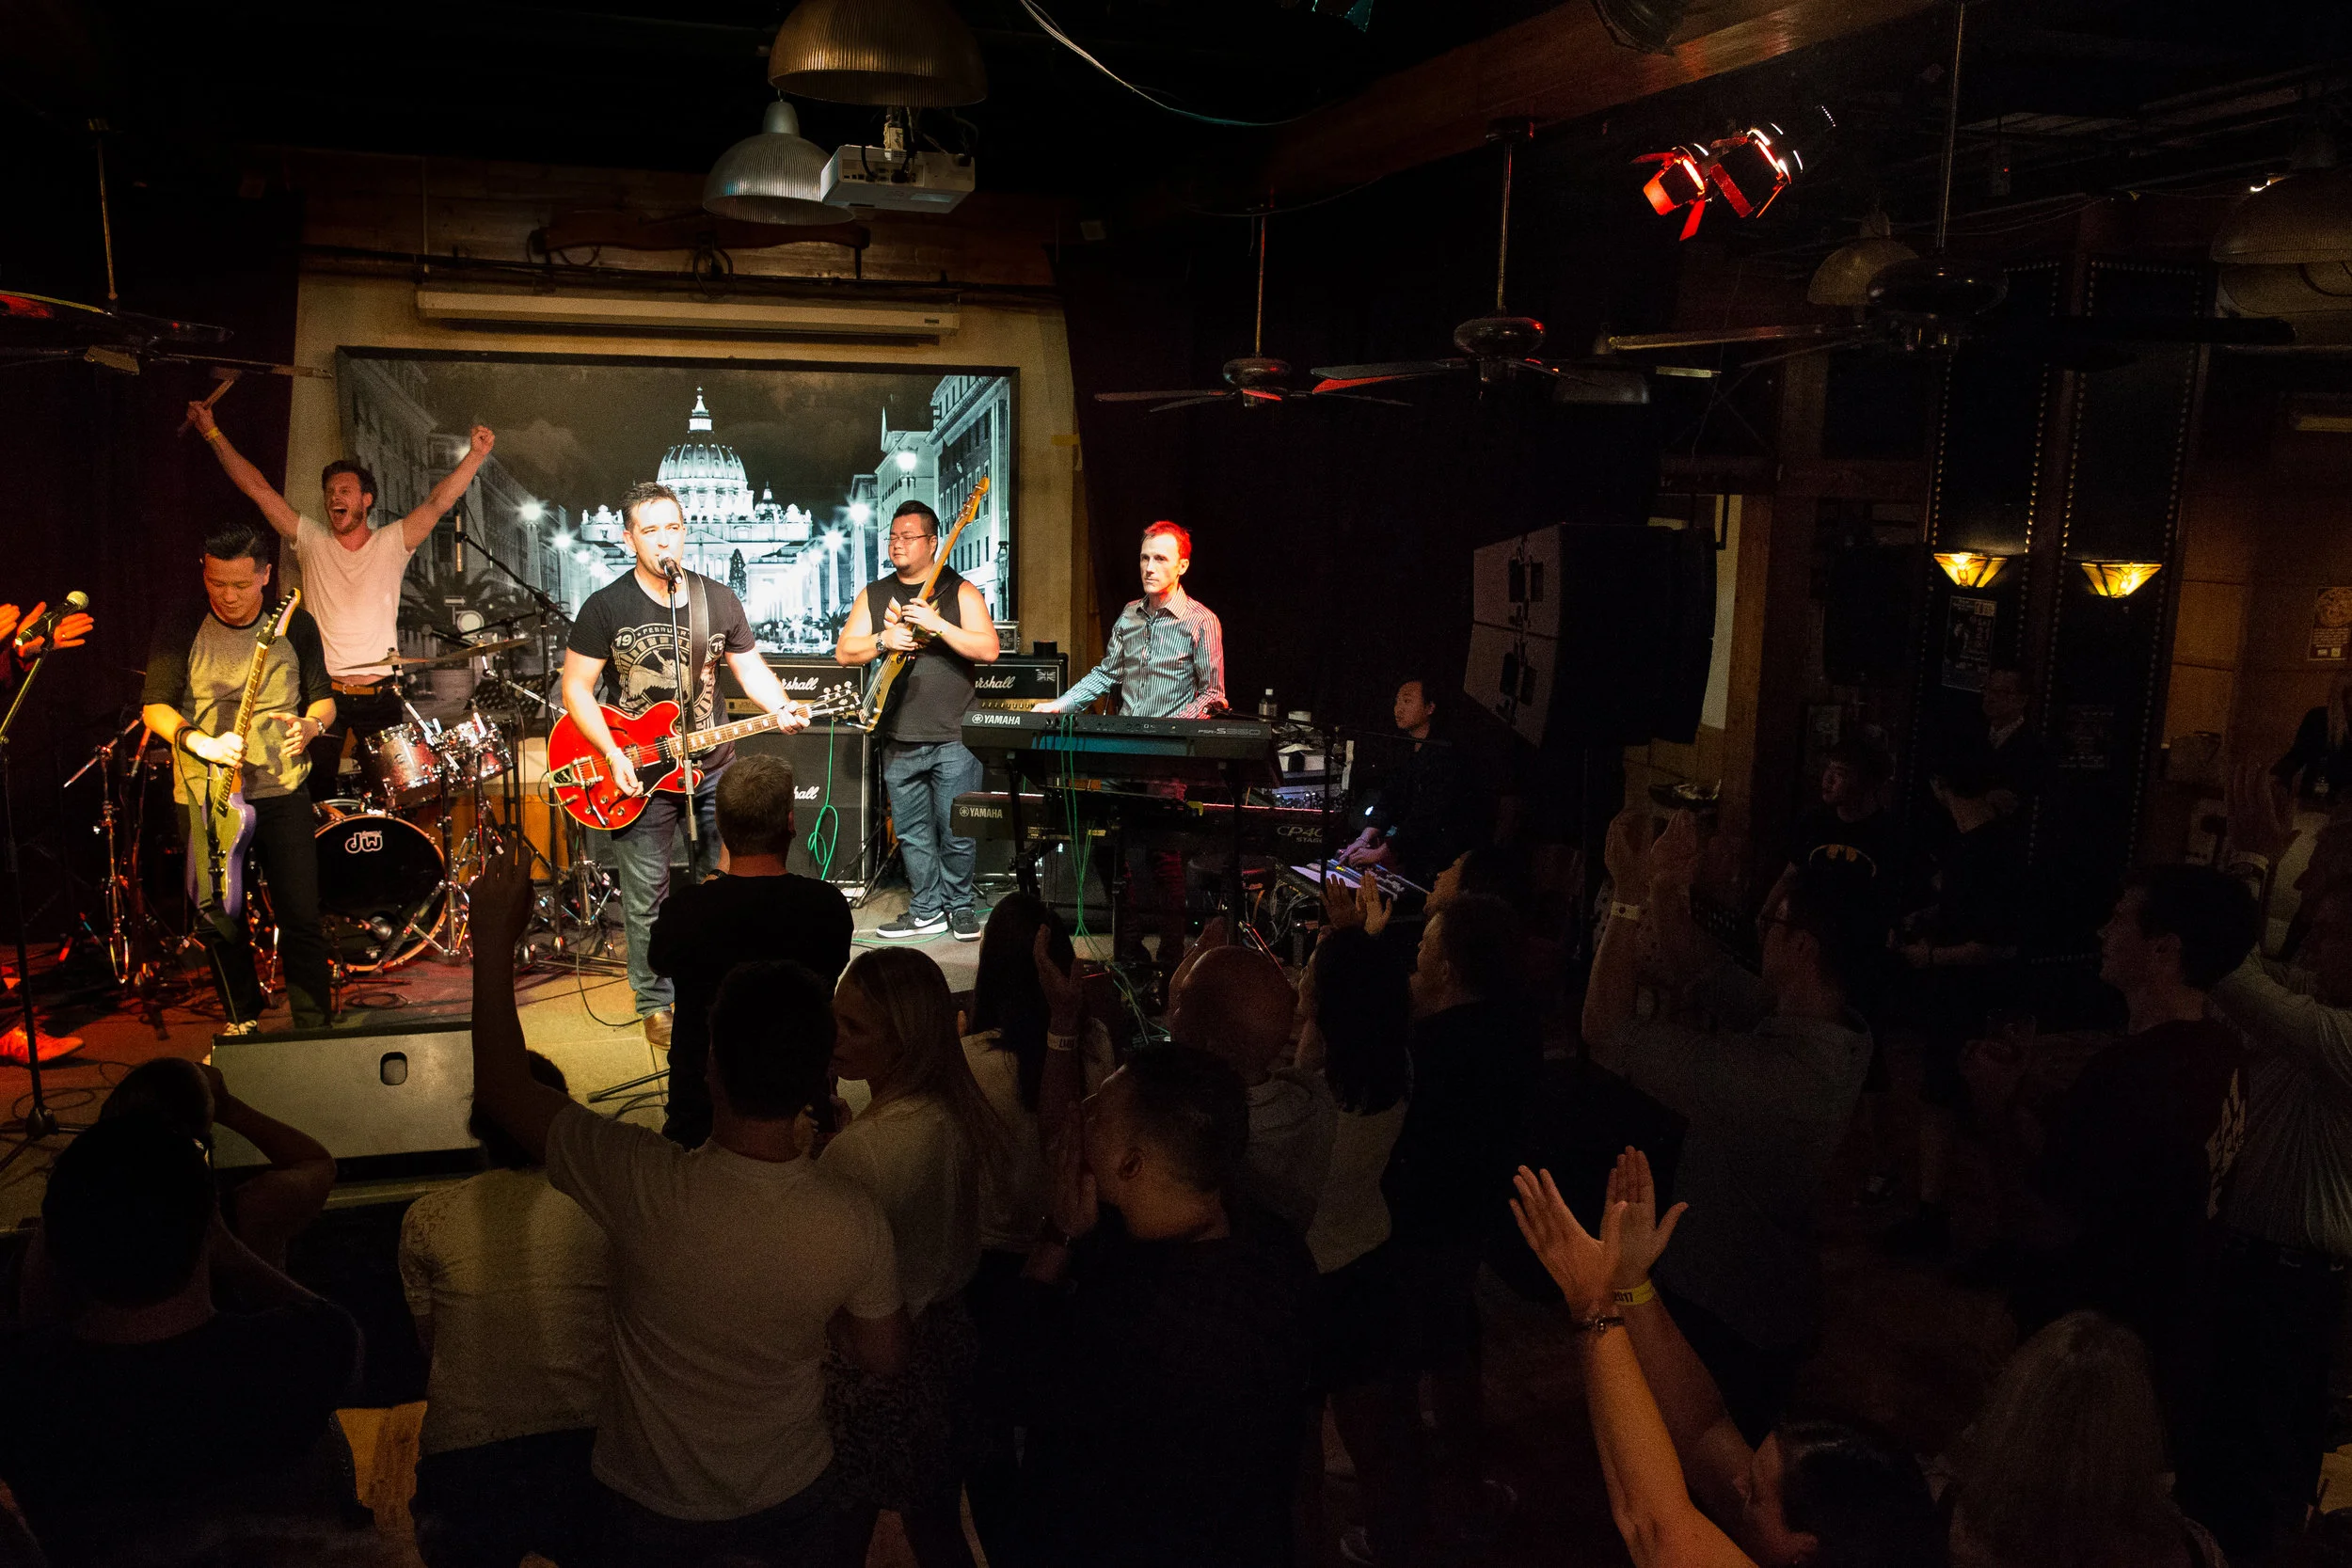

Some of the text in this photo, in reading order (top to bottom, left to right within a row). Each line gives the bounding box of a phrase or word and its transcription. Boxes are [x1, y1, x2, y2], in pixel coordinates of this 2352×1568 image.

[644, 626, 690, 637] FEBRUR
[614, 634, 632, 647] 19
[711, 641, 723, 652] 75
[781, 677, 818, 690] rshall
[984, 715, 1021, 725] YAMAHA
[794, 785, 819, 800] hall
[970, 808, 1003, 818] YAMAHA
